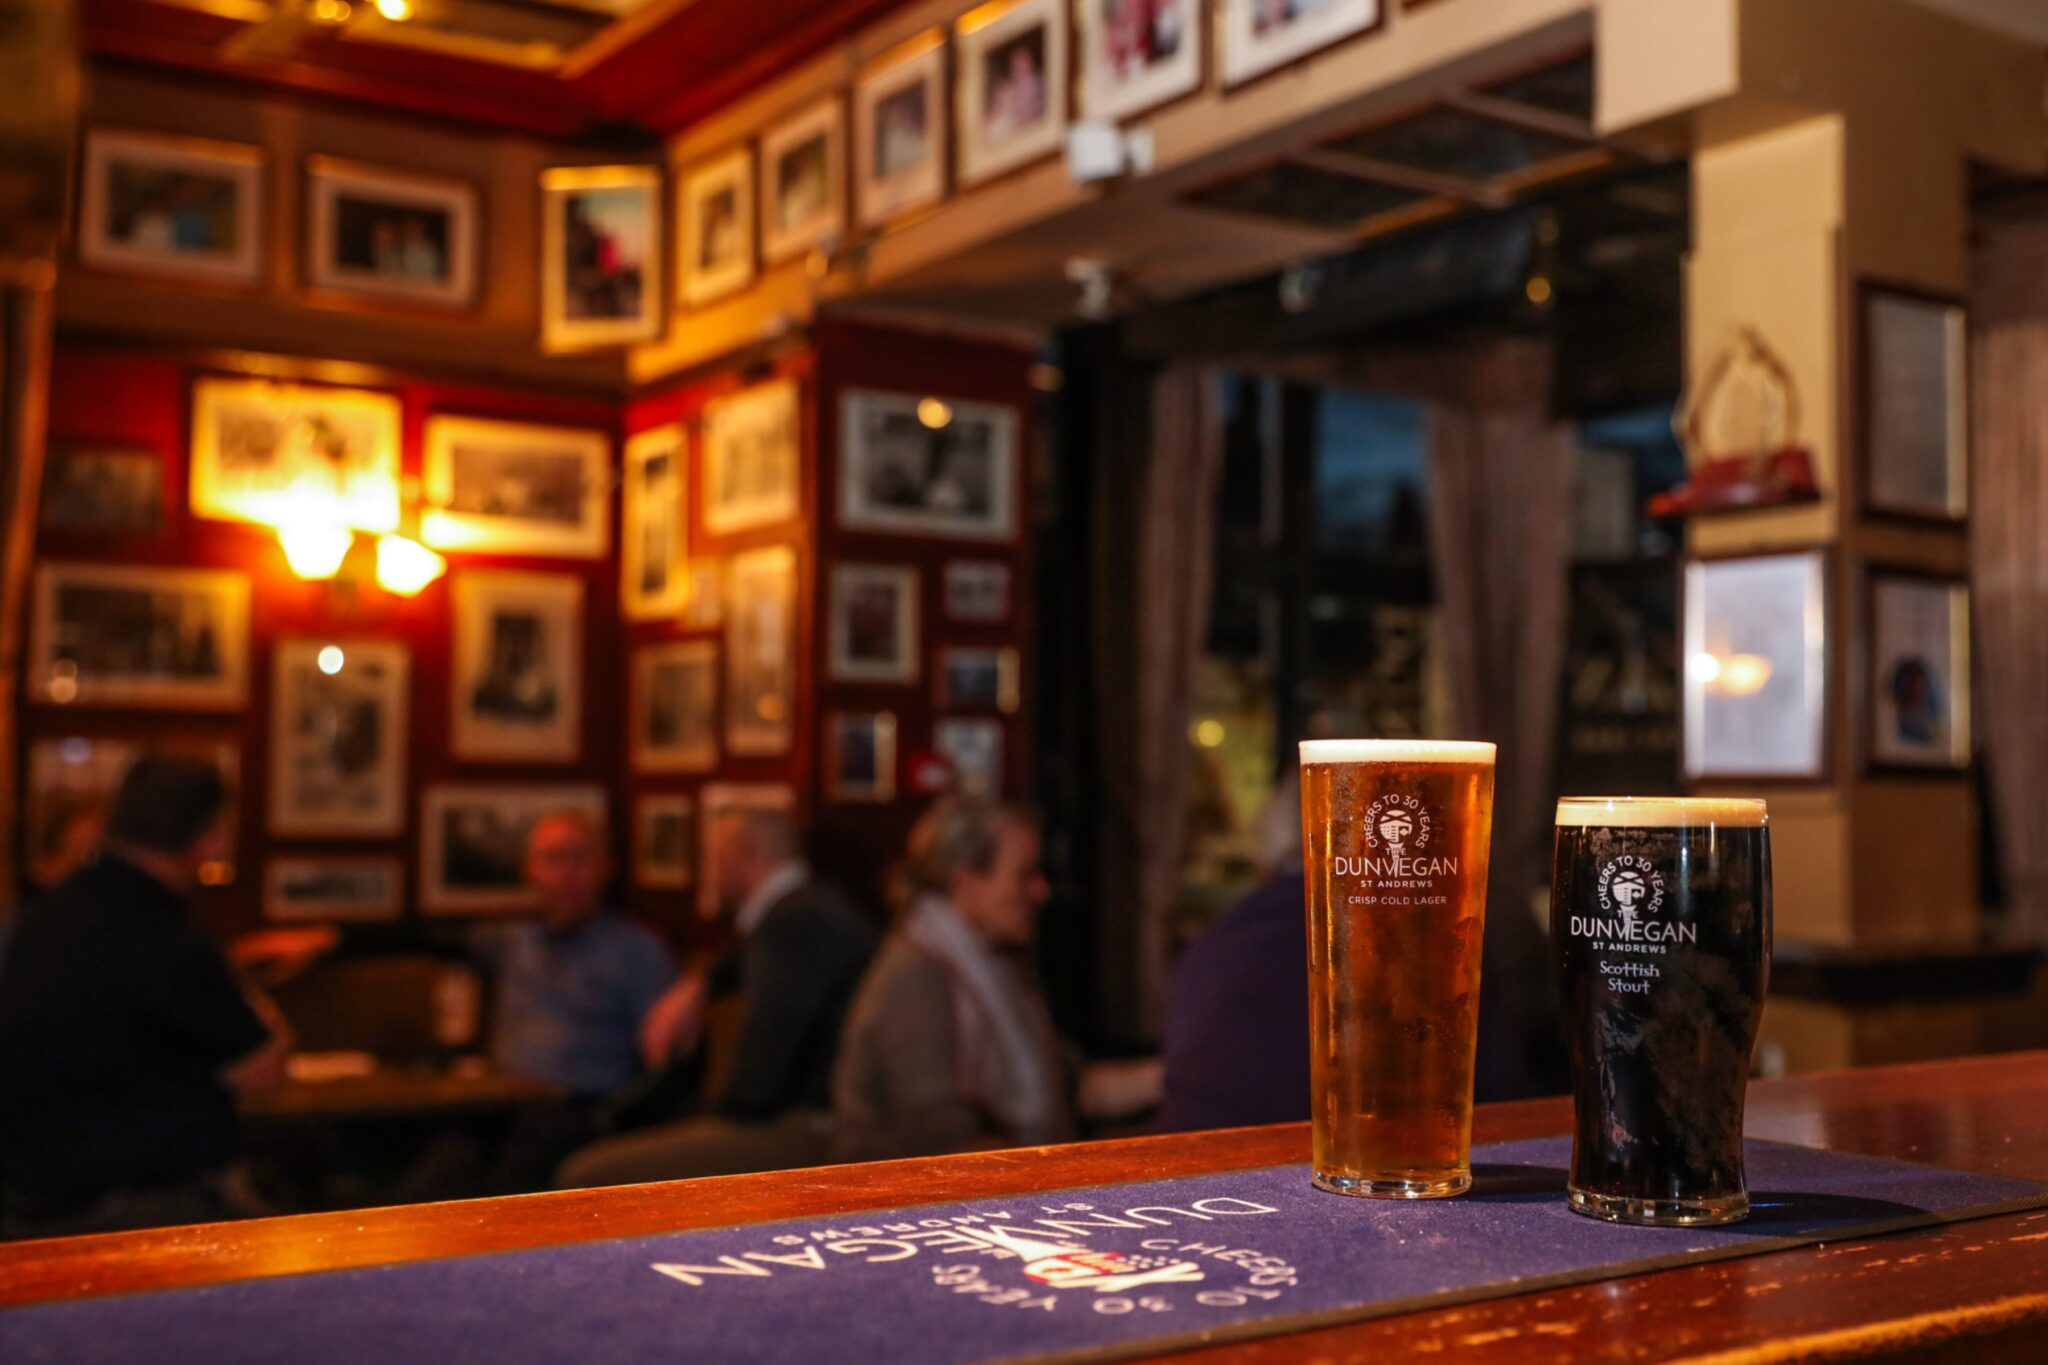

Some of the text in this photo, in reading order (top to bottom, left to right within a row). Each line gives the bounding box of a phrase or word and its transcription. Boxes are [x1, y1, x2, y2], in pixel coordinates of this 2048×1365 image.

[1364, 793, 1431, 849] CHEERS TO 30 YEARS
[1335, 856, 1457, 877] DUNVEGAN
[1360, 880, 1433, 888] ST ANDREWS
[1598, 855, 1664, 912] CHEERS TO 30 YEARS
[1348, 896, 1447, 905] CRISP COLD LAGER
[1571, 916, 1696, 943] DUNVEGAN
[1592, 941, 1666, 953] ST ANDREWS
[1600, 960, 1660, 977] Scottish
[1608, 978, 1651, 995] Stout
[772, 1202, 1094, 1246] ST ANDREWS
[651, 1197, 1280, 1287] DUNVEGAN
[1139, 1238, 1298, 1286] CHEERS
[933, 1264, 1058, 1311] YEARS
[1195, 1284, 1281, 1306] TO
